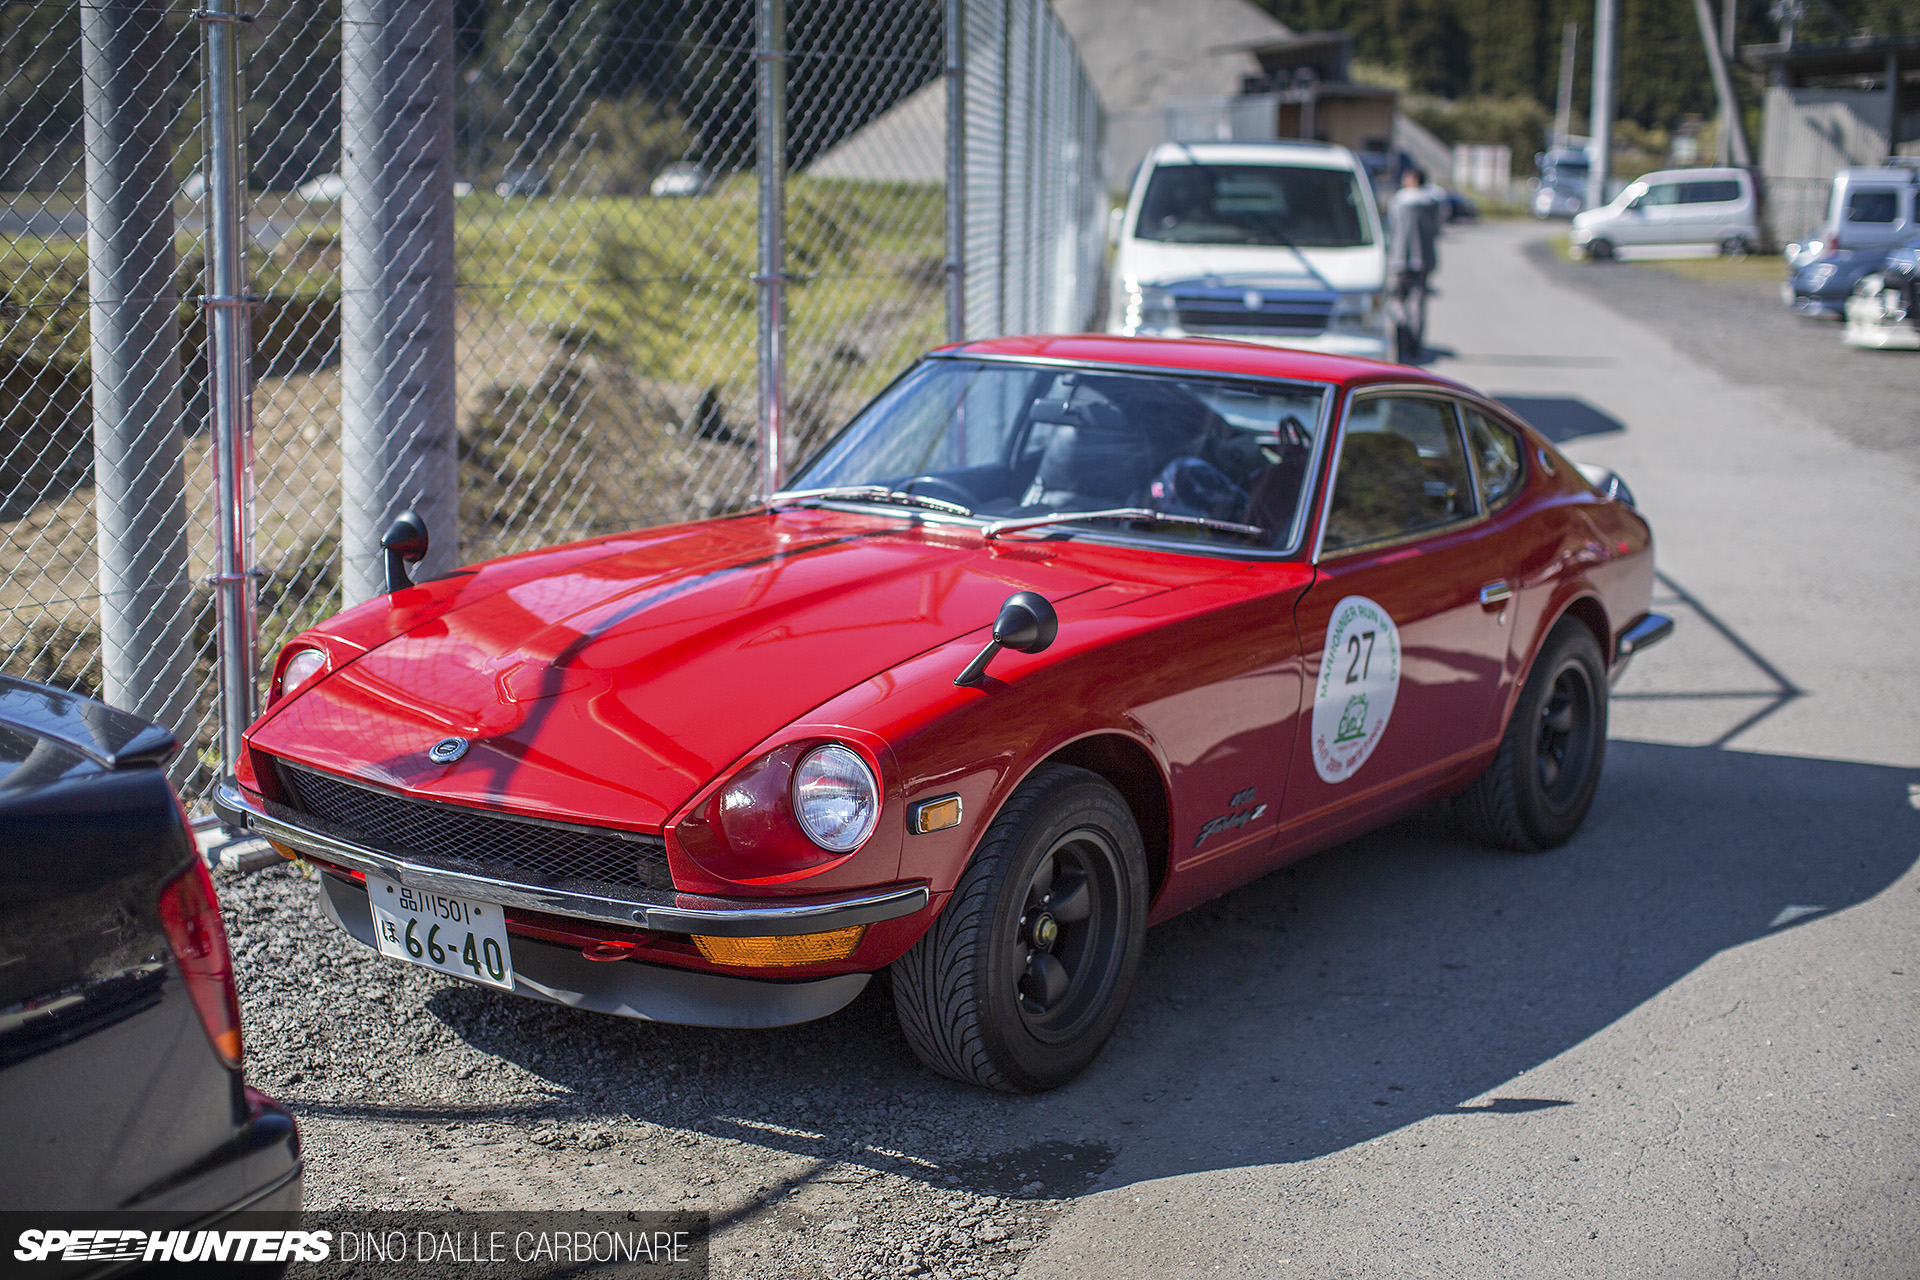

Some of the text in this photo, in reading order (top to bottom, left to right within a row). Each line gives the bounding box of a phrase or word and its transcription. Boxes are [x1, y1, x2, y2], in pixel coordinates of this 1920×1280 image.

[1357, 604, 1379, 624] RUN
[1345, 630, 1376, 685] 27
[381, 917, 506, 982] ほ 66-40
